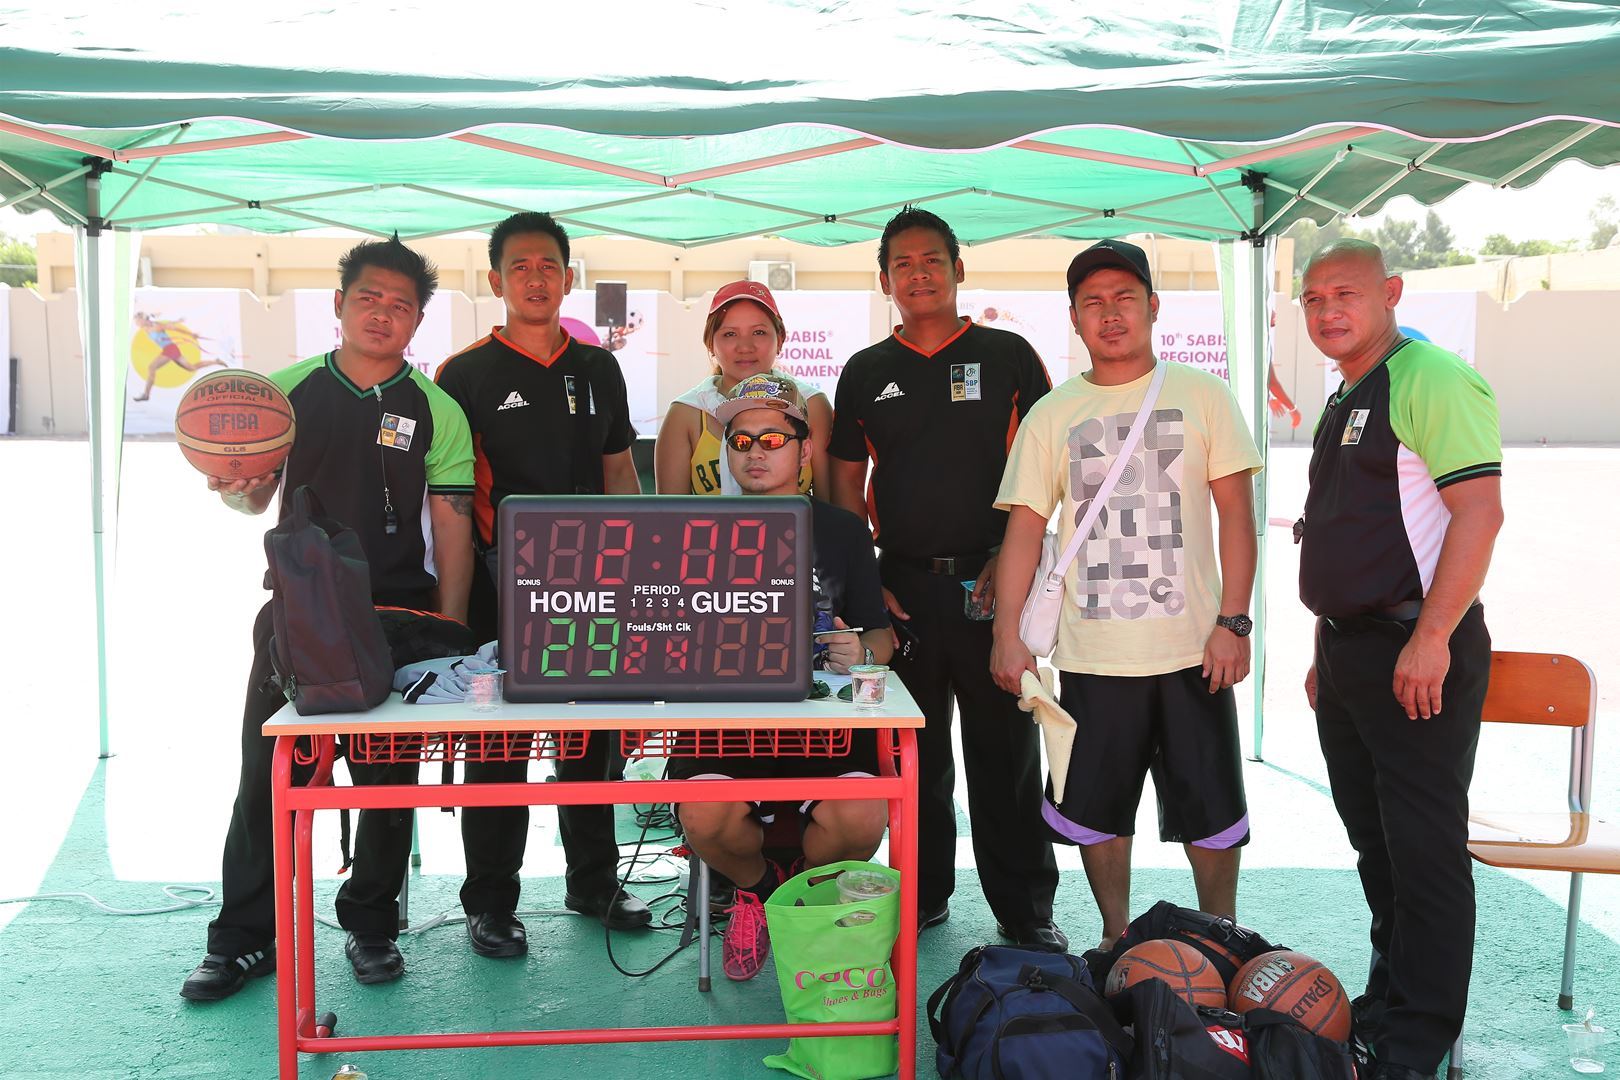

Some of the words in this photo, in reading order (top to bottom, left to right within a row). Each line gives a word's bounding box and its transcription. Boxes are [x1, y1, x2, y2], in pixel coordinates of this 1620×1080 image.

[1161, 332, 1182, 346] 10th
[778, 348, 833, 360] IONAL
[1160, 351, 1227, 363] REGIONA
[193, 379, 273, 401] molten
[207, 394, 257, 402] OFFICIAL
[874, 391, 906, 402] ACCEL
[497, 401, 530, 411] ACCEL
[221, 413, 258, 431] FIBA
[770, 578, 795, 586] BONUS
[633, 585, 681, 595] PERIOD
[530, 591, 616, 613] HOME
[630, 598, 636, 607] 1
[645, 598, 653, 607] 2
[661, 598, 669, 607] 3
[677, 598, 685, 607] 4
[691, 591, 785, 614] GUEST
[626, 622, 672, 632] Fouls/Sht
[675, 622, 692, 632] Clk
[541, 617, 620, 677] 29
[1242, 962, 1287, 1004] NBA
[851, 991, 860, 1001] &
[1289, 974, 1333, 1019] SPALD
